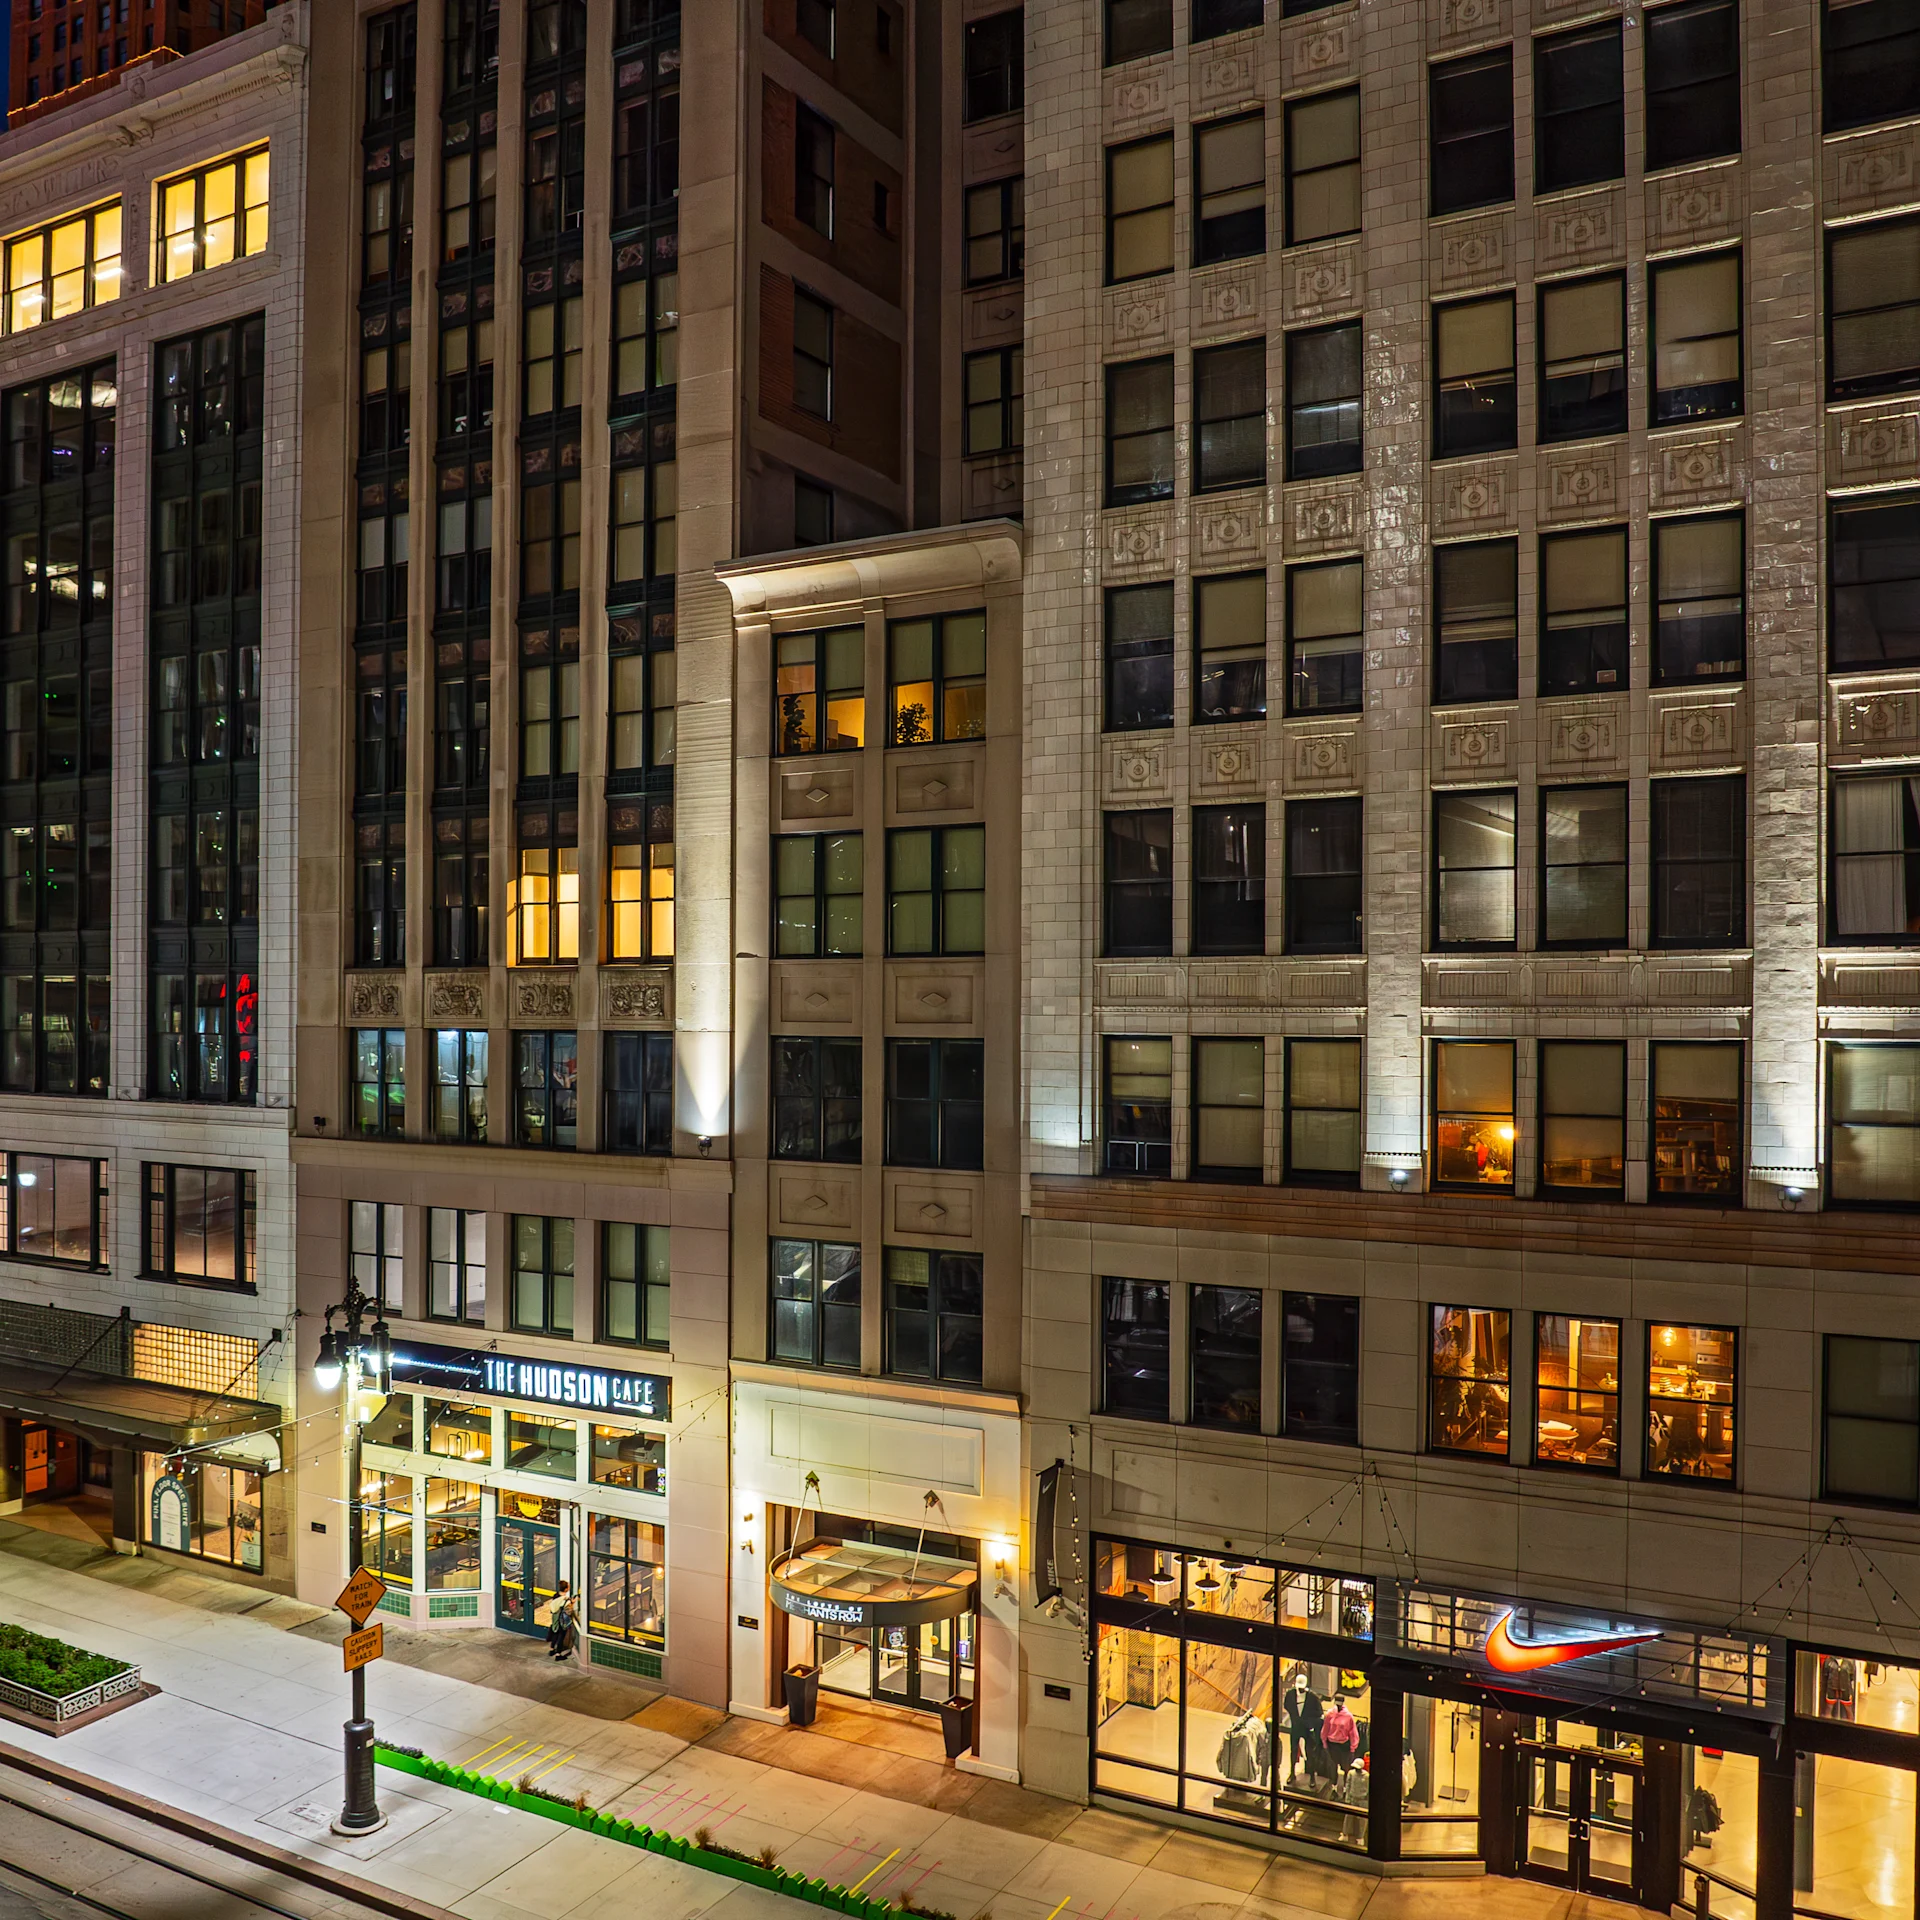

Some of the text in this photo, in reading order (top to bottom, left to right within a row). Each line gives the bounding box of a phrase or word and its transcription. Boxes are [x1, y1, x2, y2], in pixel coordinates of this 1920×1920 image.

[484, 1359, 654, 1407] THE HUDSON CAFE
[154, 1479, 171, 1496] FLOOR
[1047, 1558, 1056, 1587] NIKE
[350, 1581, 373, 1593] WATCH
[354, 1591, 369, 1602] FOR
[351, 1600, 372, 1611] TRAIN
[838, 1612, 863, 1622] ROW
[350, 1631, 376, 1647] CAUTION
[349, 1639, 378, 1656] SLIPPERY
[355, 1650, 373, 1662] RAILS
